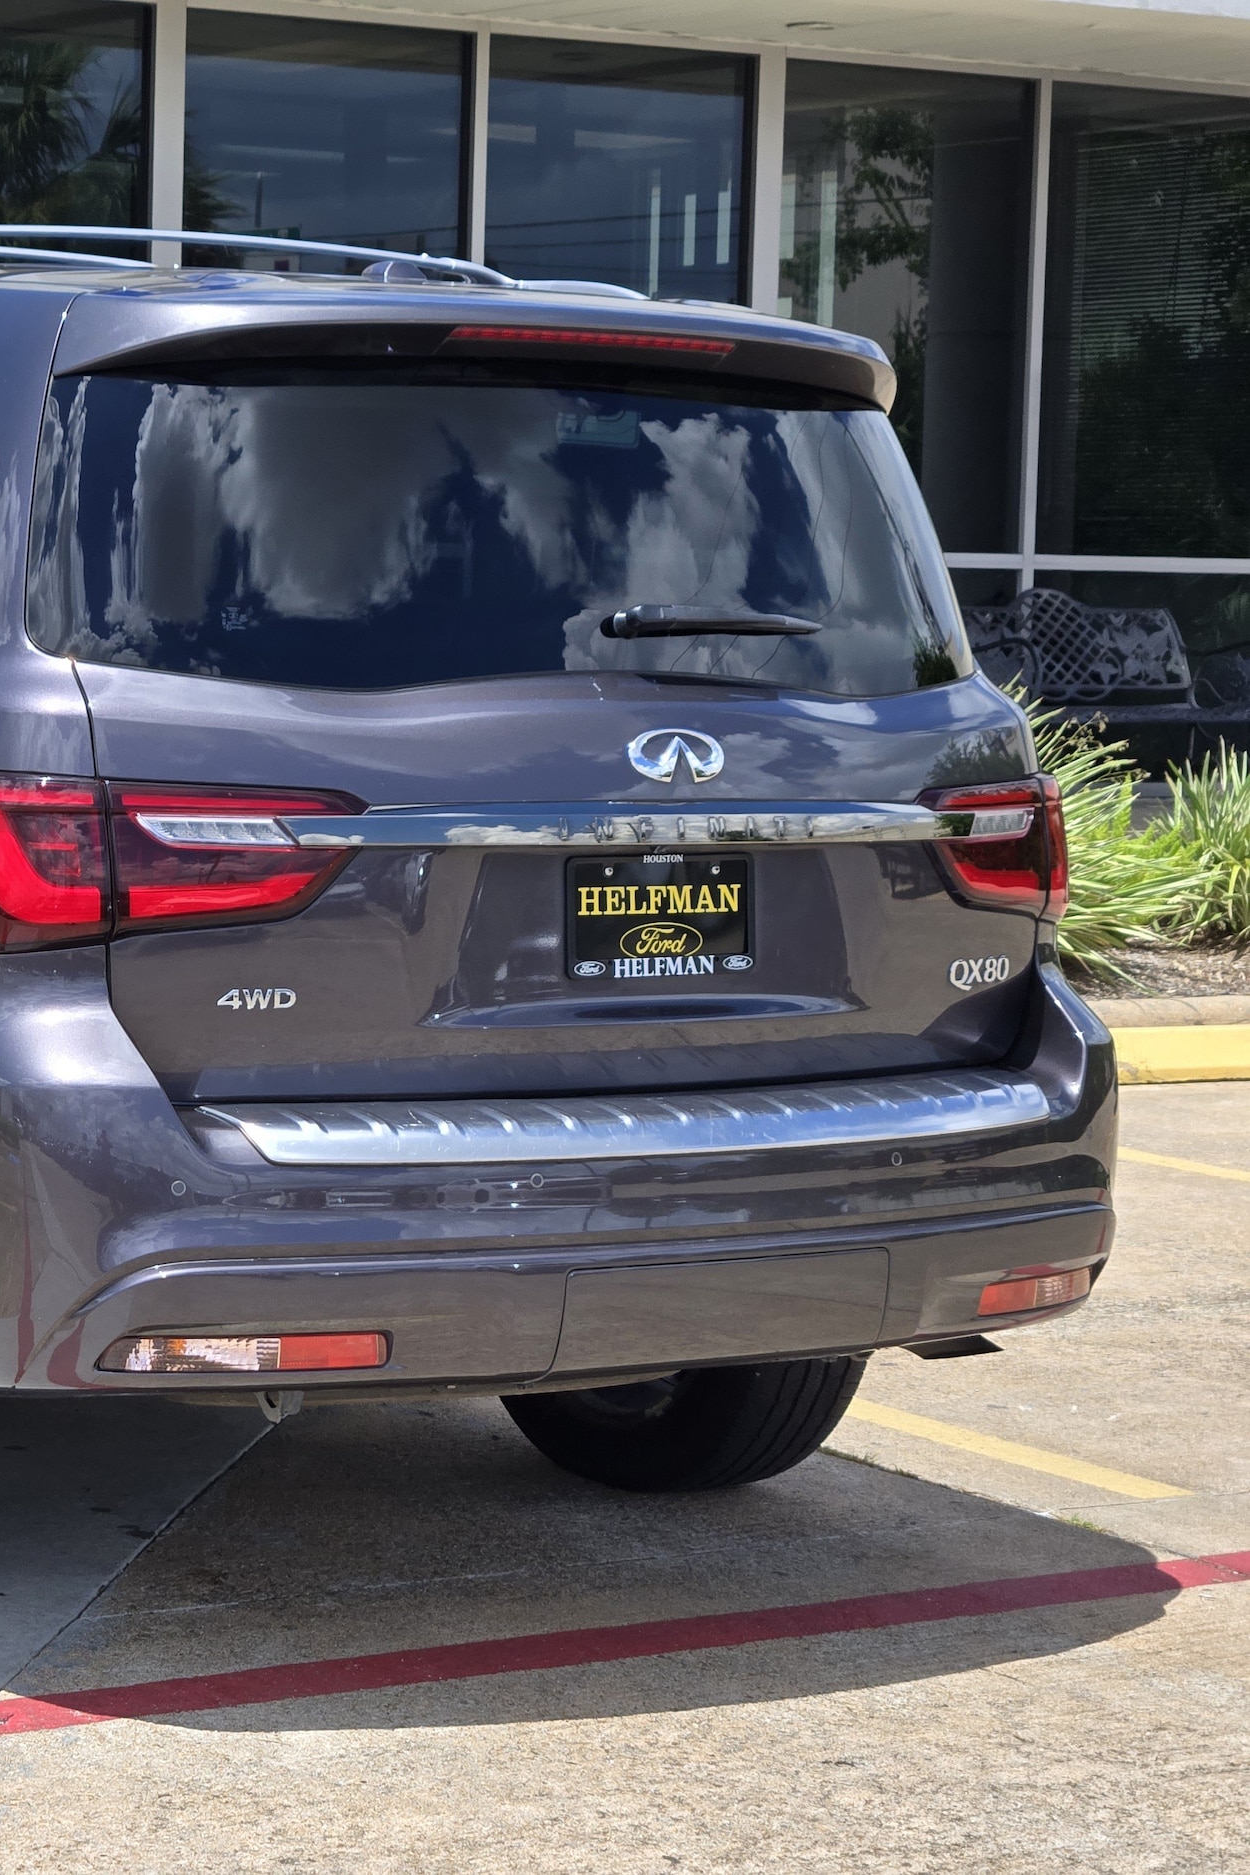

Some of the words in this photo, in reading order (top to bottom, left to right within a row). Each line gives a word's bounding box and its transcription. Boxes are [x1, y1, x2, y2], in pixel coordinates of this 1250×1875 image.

[558, 815, 815, 842] INFINITI
[643, 854, 684, 864] HOUSTON
[577, 884, 742, 916] HELFMAN
[635, 927, 688, 955] Ford
[613, 954, 716, 979] HELFMAN
[949, 954, 1010, 991] QX80
[216, 987, 297, 1010] 4WD
